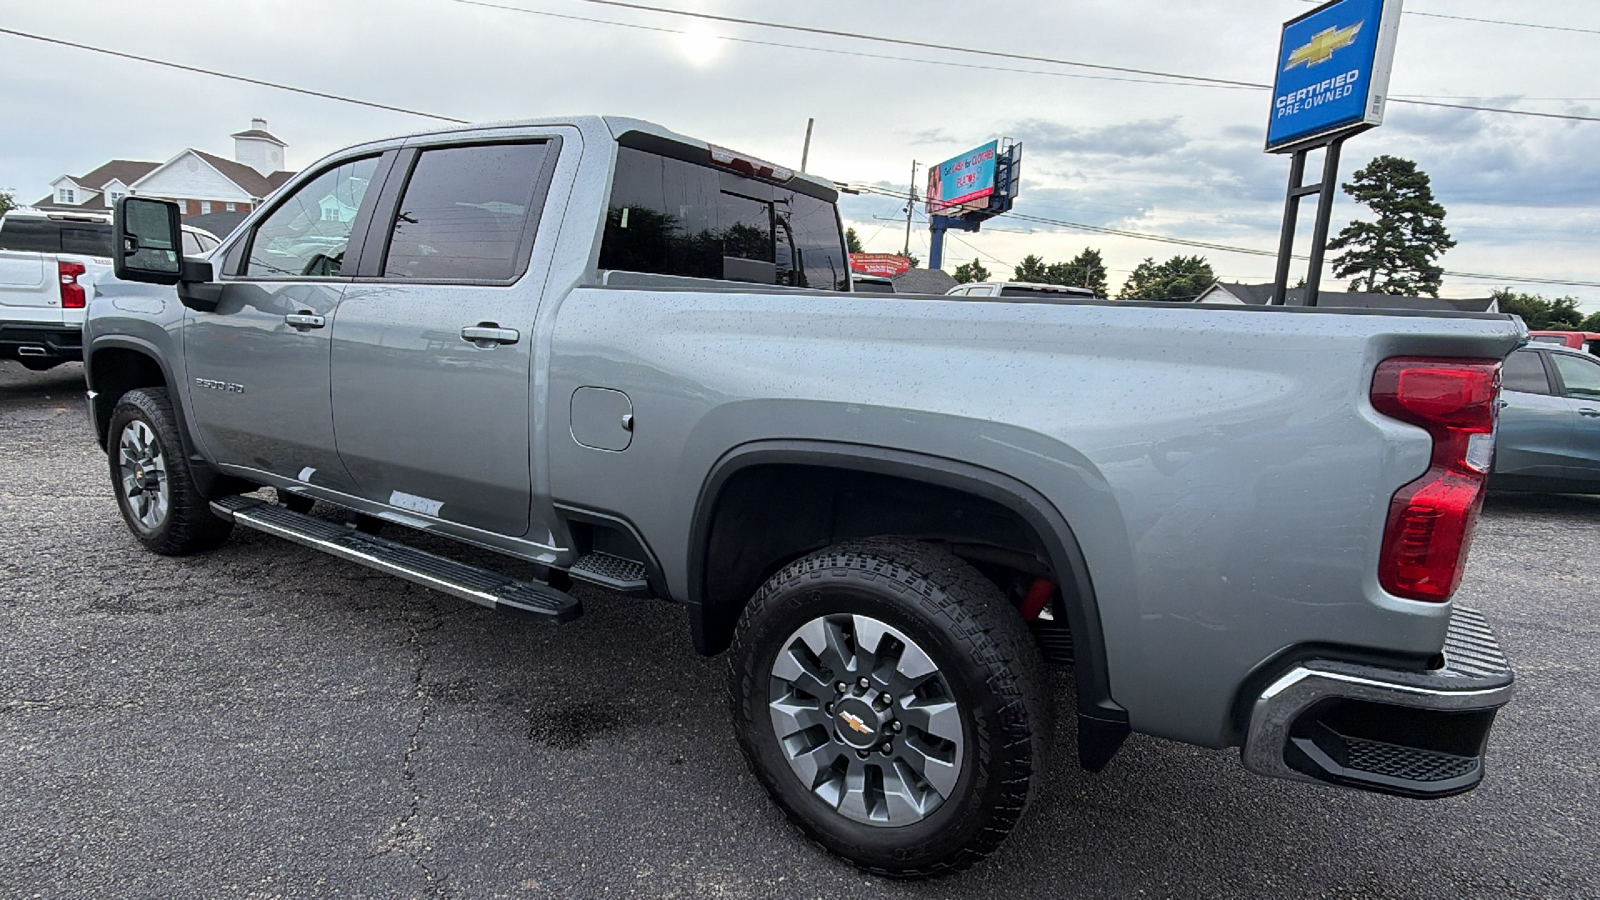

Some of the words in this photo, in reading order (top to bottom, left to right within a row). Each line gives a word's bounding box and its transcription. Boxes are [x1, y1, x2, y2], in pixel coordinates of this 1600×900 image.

[1276, 69, 1359, 108] CERTIFIED
[1277, 84, 1353, 119] PRE-OWNED
[951, 161, 964, 173] CASH
[971, 148, 994, 165] CLOTHES
[228, 382, 244, 393] HD
